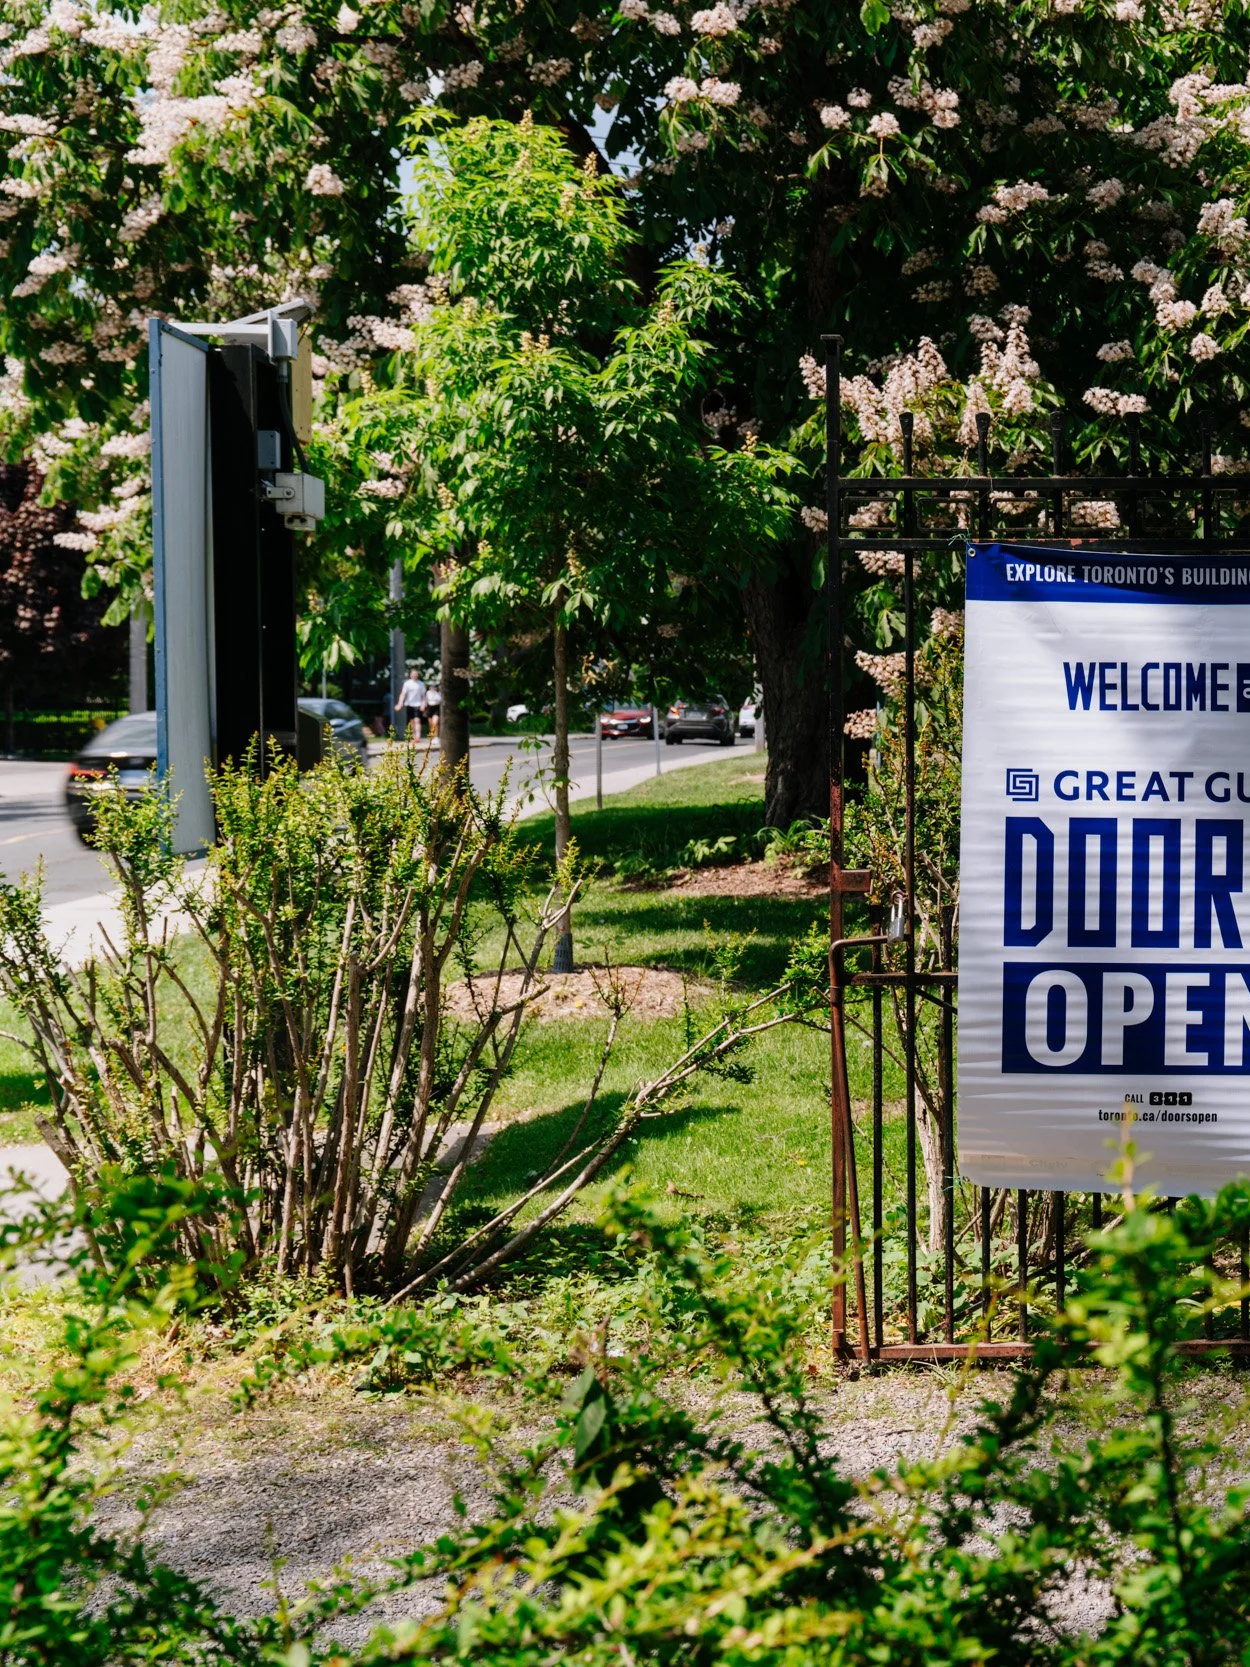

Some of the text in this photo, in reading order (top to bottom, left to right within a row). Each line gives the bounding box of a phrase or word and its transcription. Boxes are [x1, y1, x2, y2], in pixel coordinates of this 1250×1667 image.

[1006, 563, 1076, 583] EXPLORE
[1082, 565, 1174, 585] TORONTO'S
[1063, 662, 1229, 711] WELCOME
[1053, 770, 1193, 802] GREAT
[1124, 1093, 1144, 1103] CALL
[1098, 1109, 1218, 1124] torono.ca/doorsopen
